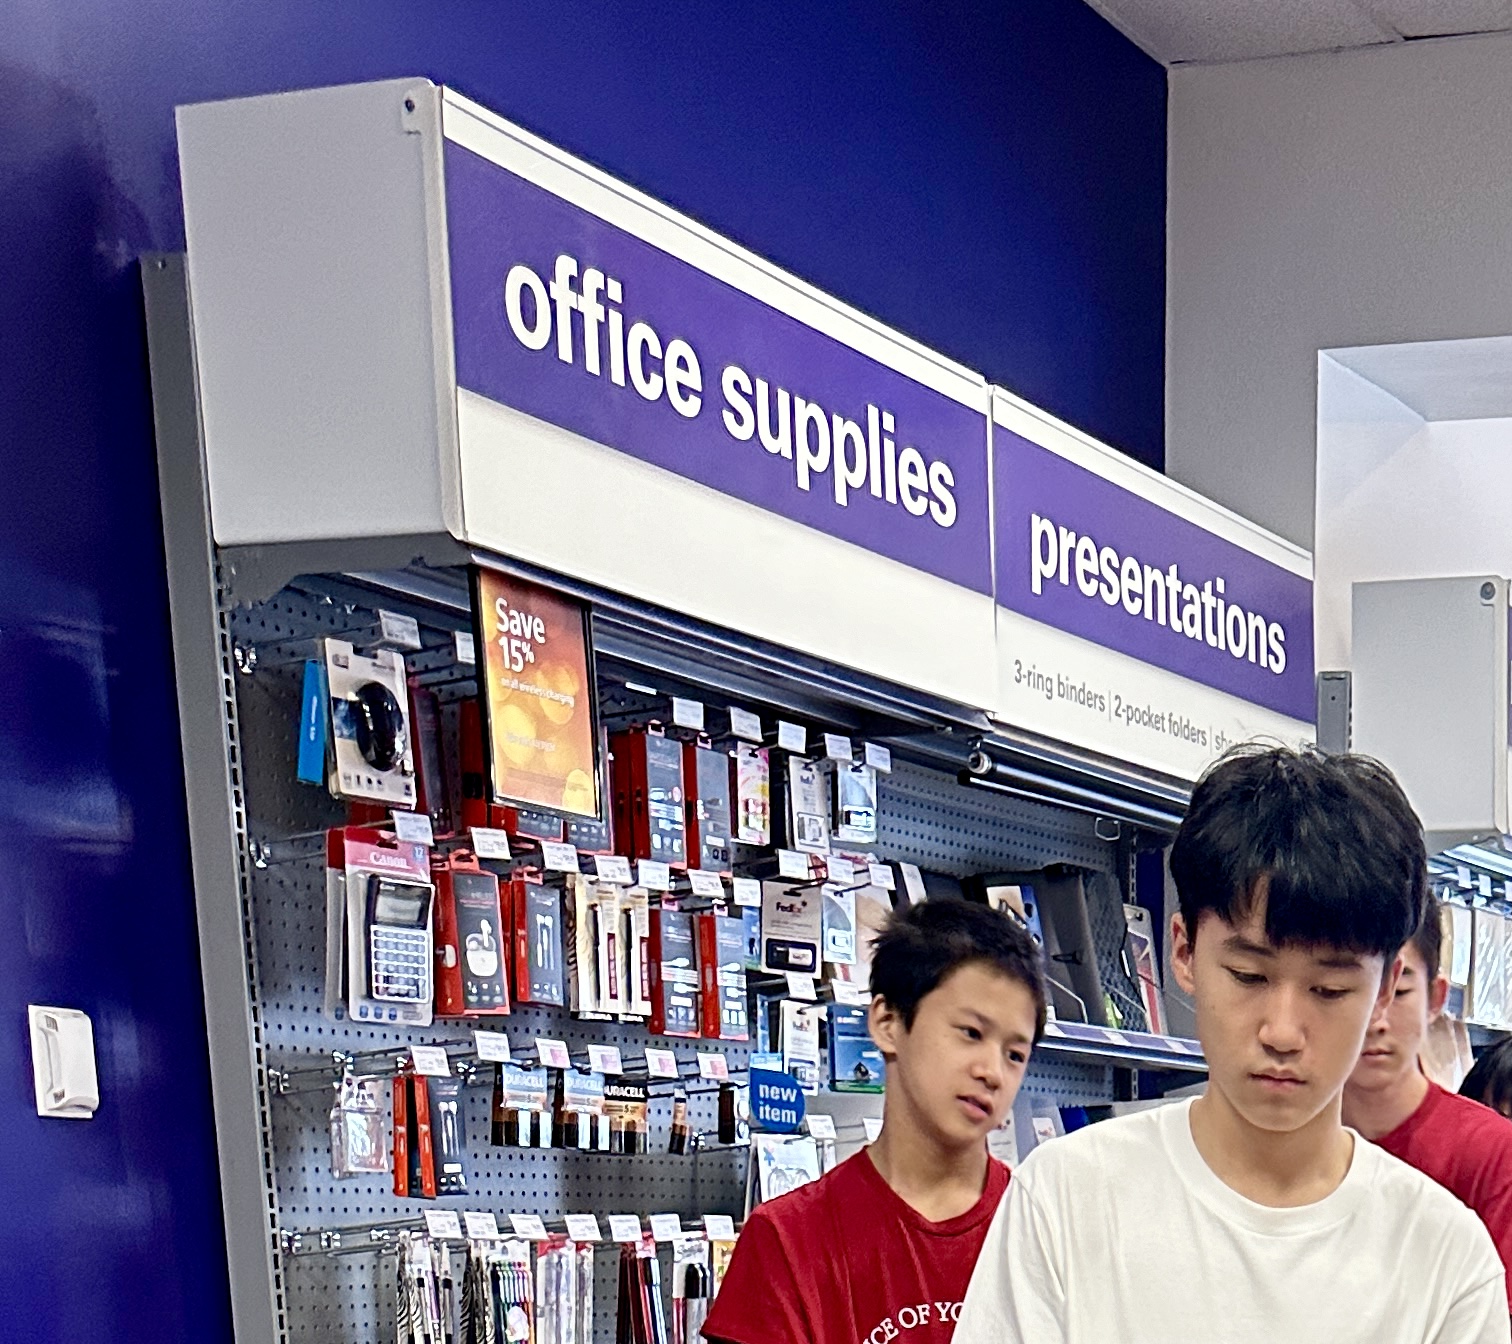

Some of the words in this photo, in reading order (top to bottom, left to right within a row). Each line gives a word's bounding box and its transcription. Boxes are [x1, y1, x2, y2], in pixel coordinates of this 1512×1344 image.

[504, 253, 702, 419] office
[722, 364, 957, 528] supplies
[1030, 512, 1287, 674] presentations
[495, 597, 546, 644] Save
[499, 636, 535, 673] 15%
[1014, 659, 1053, 699] 3-ring
[1057, 673, 1105, 713] binders
[1114, 694, 1166, 734] 2-pocket
[1168, 712, 1207, 747] folders
[369, 851, 408, 868] Canon
[758, 1082, 798, 1103] new
[758, 1101, 798, 1125] item
[898, 1303, 931, 1329] OF
